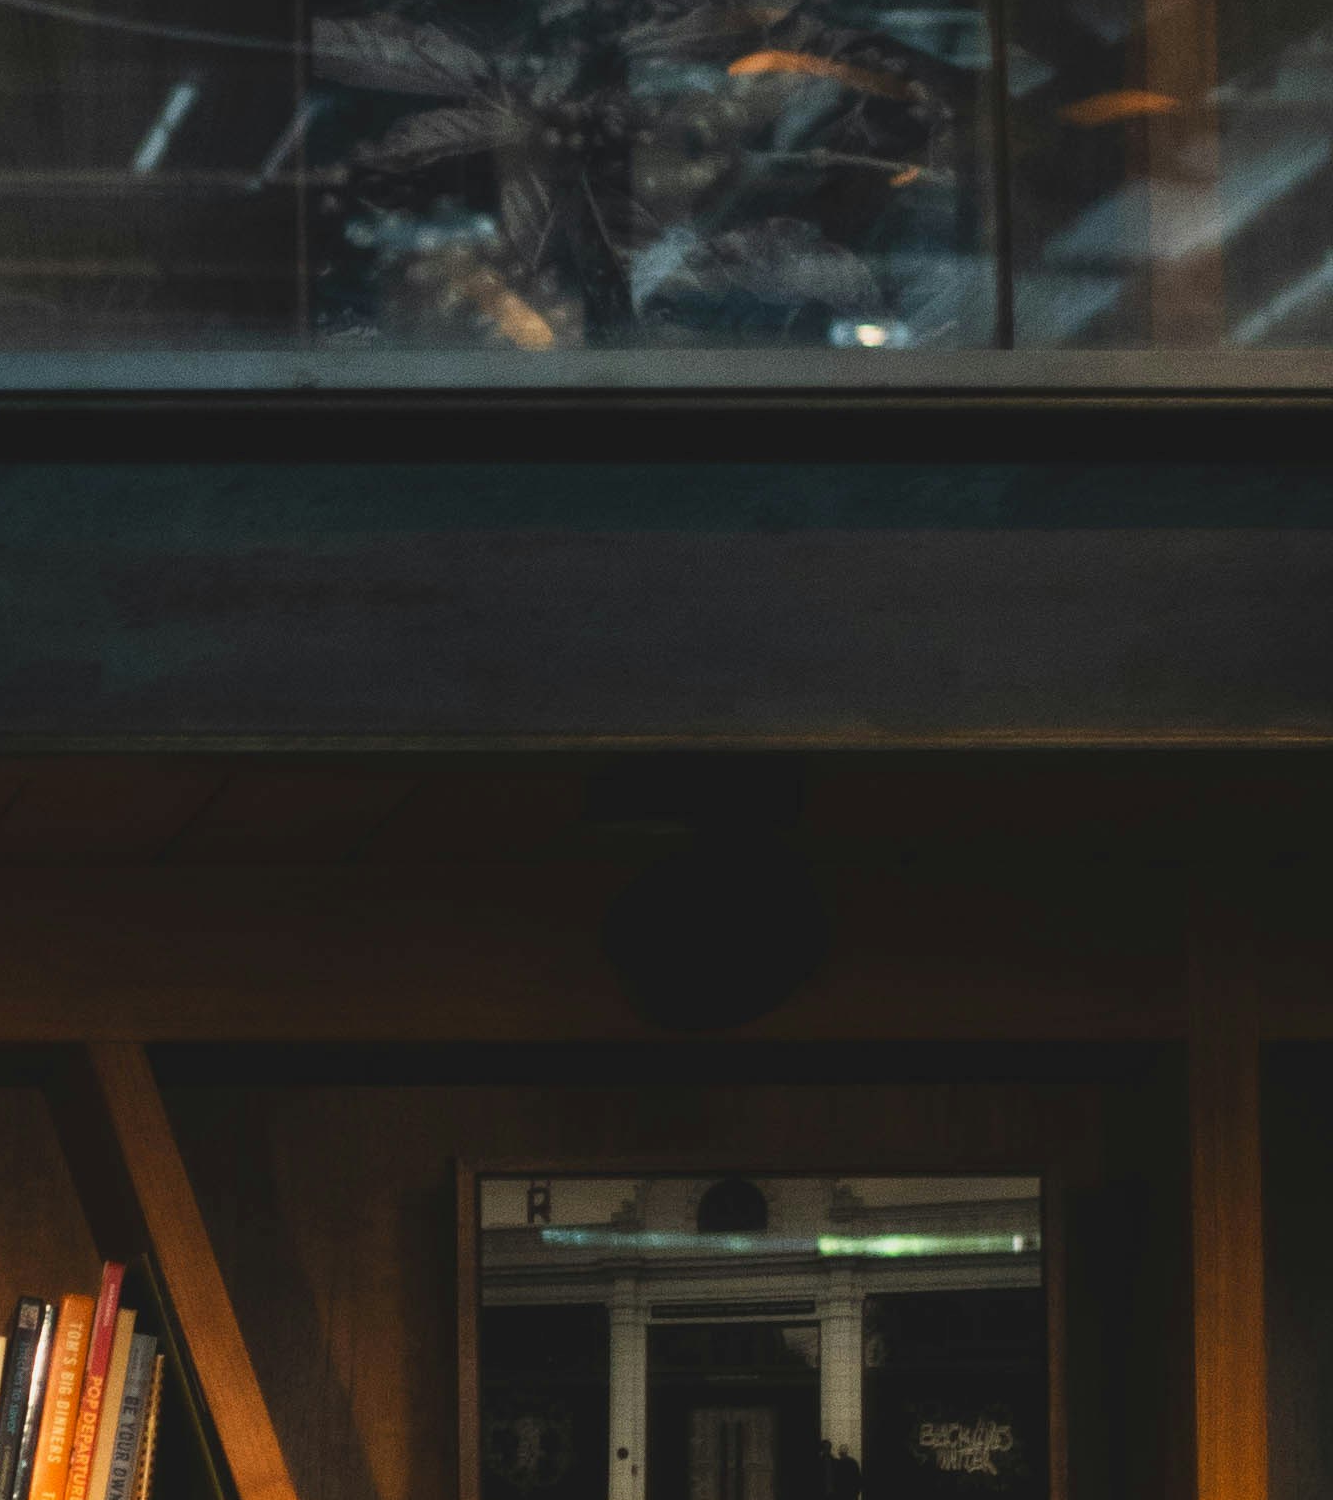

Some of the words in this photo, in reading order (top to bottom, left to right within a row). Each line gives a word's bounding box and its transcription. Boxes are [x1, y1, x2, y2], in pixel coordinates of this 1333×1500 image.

[61, 1320, 83, 1366] TOM'S
[58, 1372, 74, 1395] BIG
[84, 1375, 102, 1410] POP
[122, 1395, 140, 1415] BE
[45, 1397, 70, 1464] DINNERS
[113, 1421, 136, 1462] YOUR
